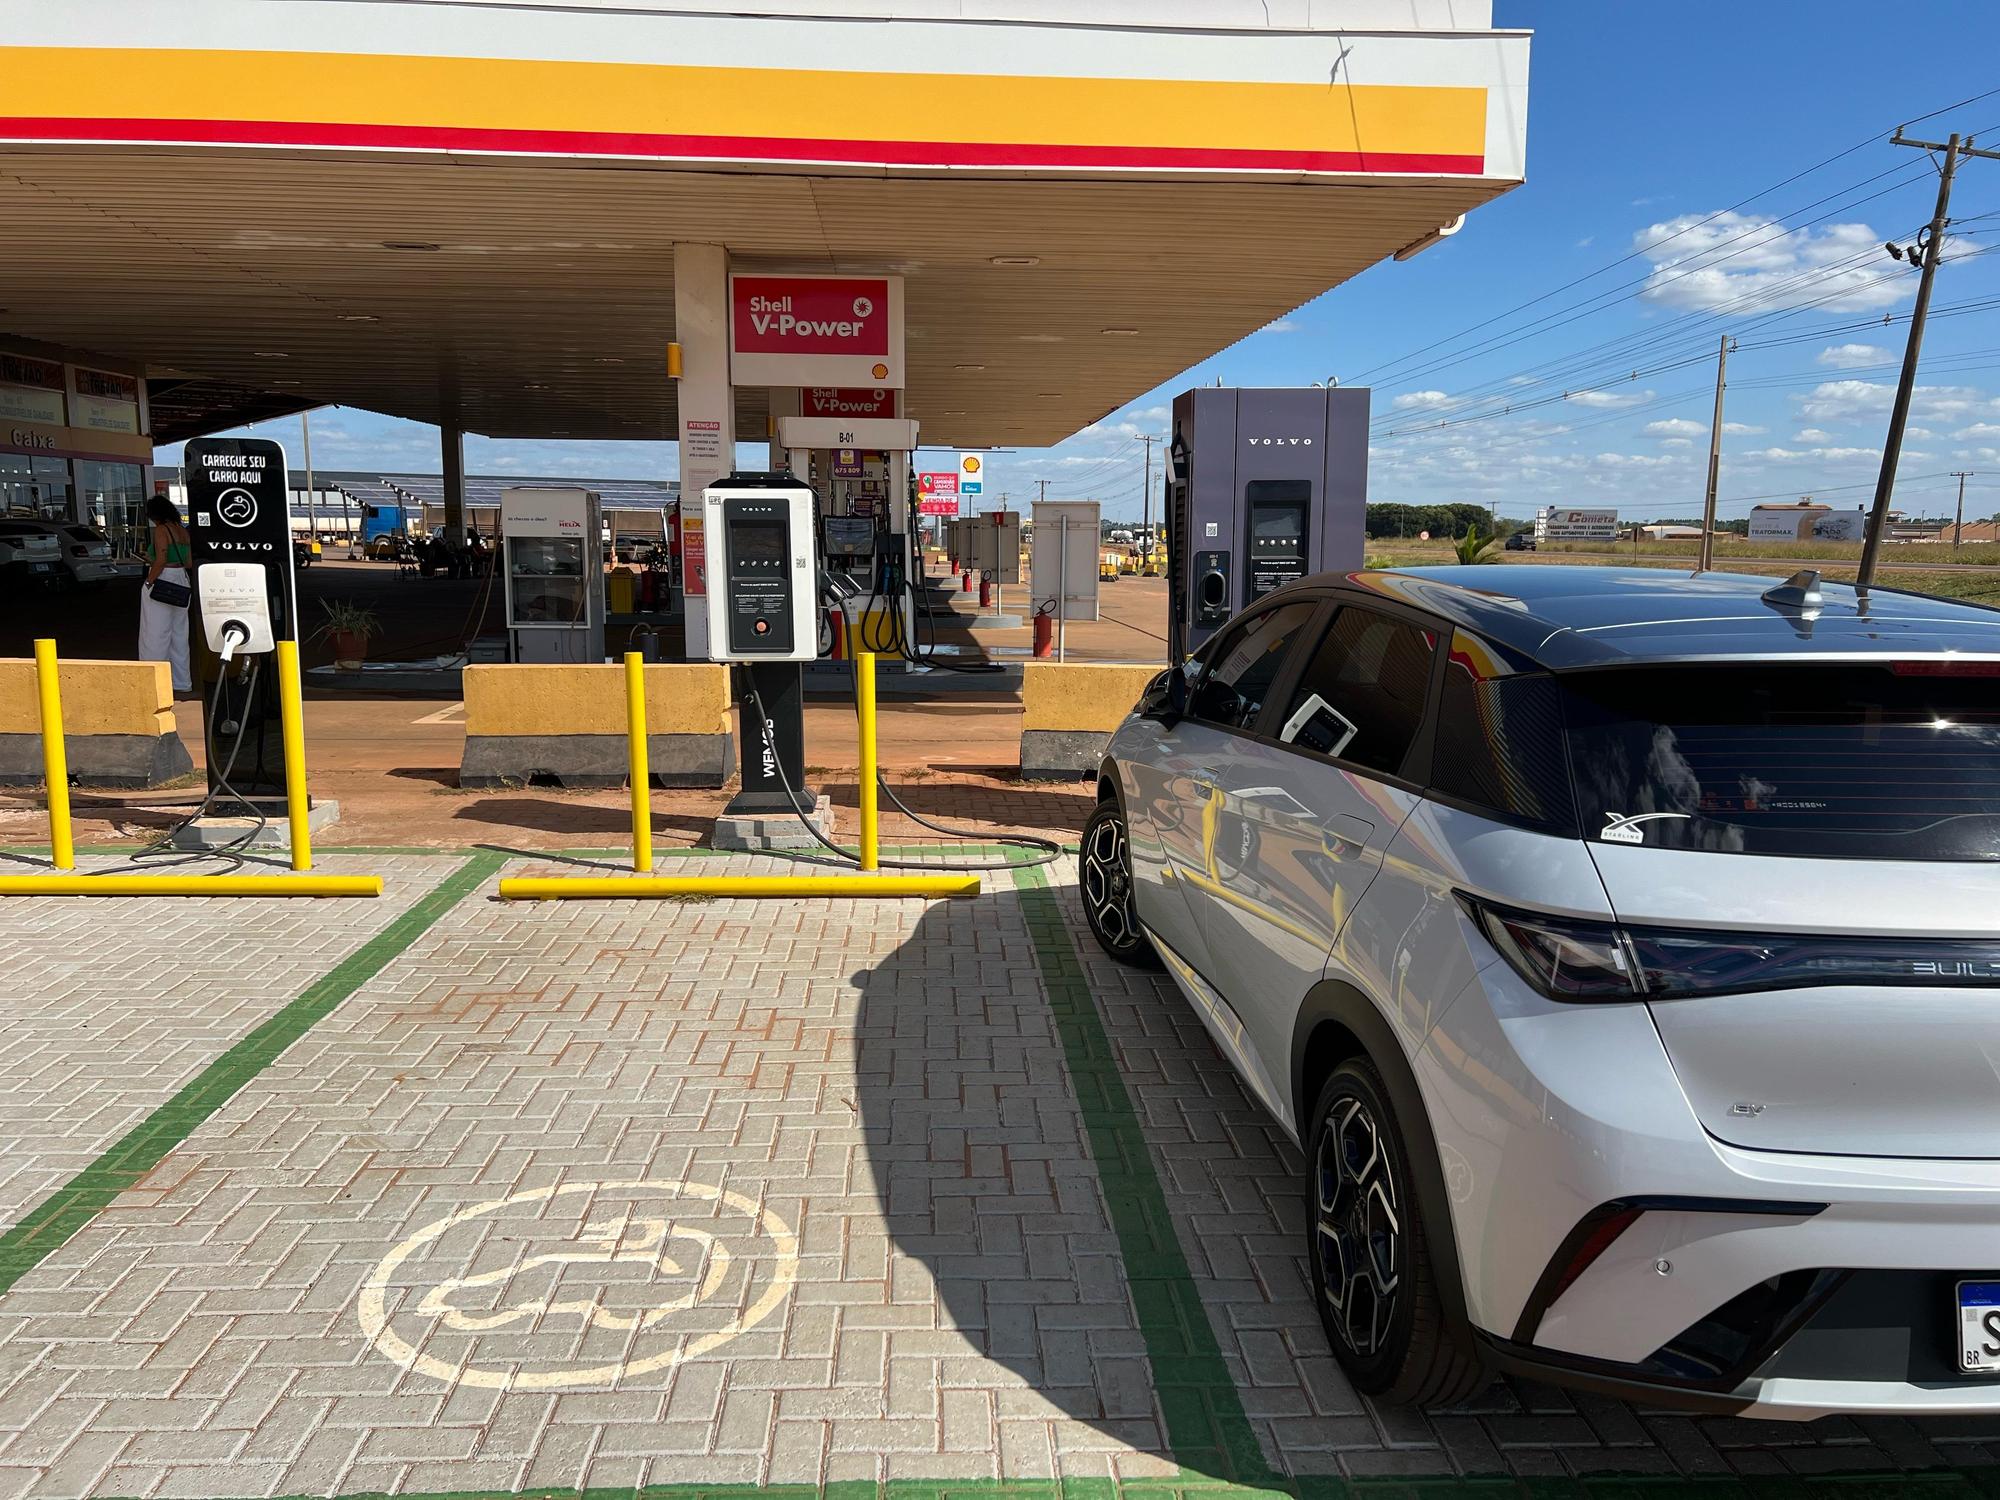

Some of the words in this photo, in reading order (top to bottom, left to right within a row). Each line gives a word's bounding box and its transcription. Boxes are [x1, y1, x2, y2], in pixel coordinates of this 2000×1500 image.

[750, 296, 792, 312] Shell
[751, 314, 864, 337] V-Power
[812, 388, 838, 398] Shell
[812, 399, 880, 412] V-Power
[688, 422, 719, 430] ATENÇÃO
[11, 429, 56, 449] Caixa
[839, 432, 854, 443] B-01
[1248, 438, 1312, 446] VOLVO
[202, 454, 248, 468] CARREGUE
[249, 456, 266, 469] SEU
[209, 470, 239, 483] CARRO
[240, 471, 262, 484] AQUI
[1568, 512, 1616, 523] Cometa
[559, 520, 581, 528] HELIX
[208, 541, 273, 551] VOLVO
[1604, 831, 1640, 840] STARLINK
[1966, 1350, 1980, 1365] BR
